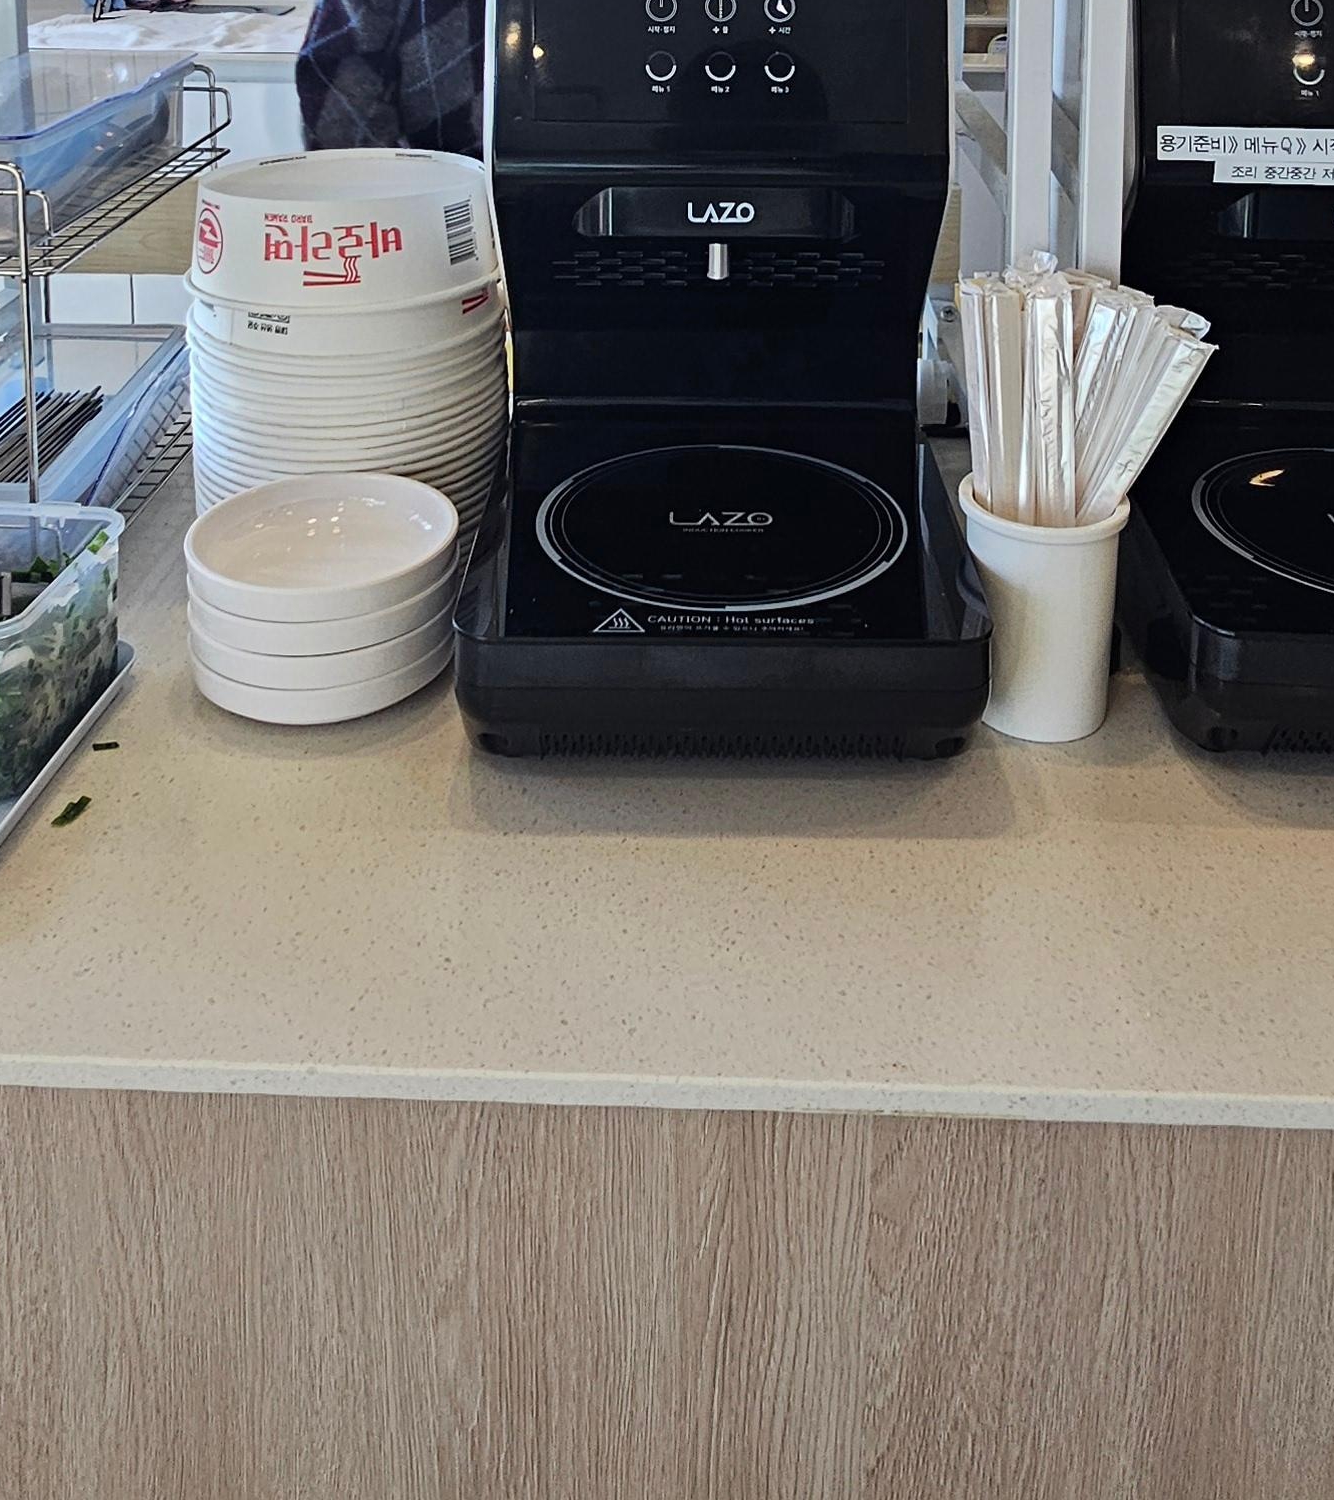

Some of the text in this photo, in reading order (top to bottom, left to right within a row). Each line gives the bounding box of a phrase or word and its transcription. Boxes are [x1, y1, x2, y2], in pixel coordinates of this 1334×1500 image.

[1231, 166, 1257, 179] 조리
[1264, 166, 1317, 180] 중간중간
[687, 202, 755, 224] LAZO
[263, 221, 403, 263] 바로라면
[669, 511, 773, 526] LAZO
[647, 615, 711, 624] CAUTION
[754, 617, 815, 625] surfaces
